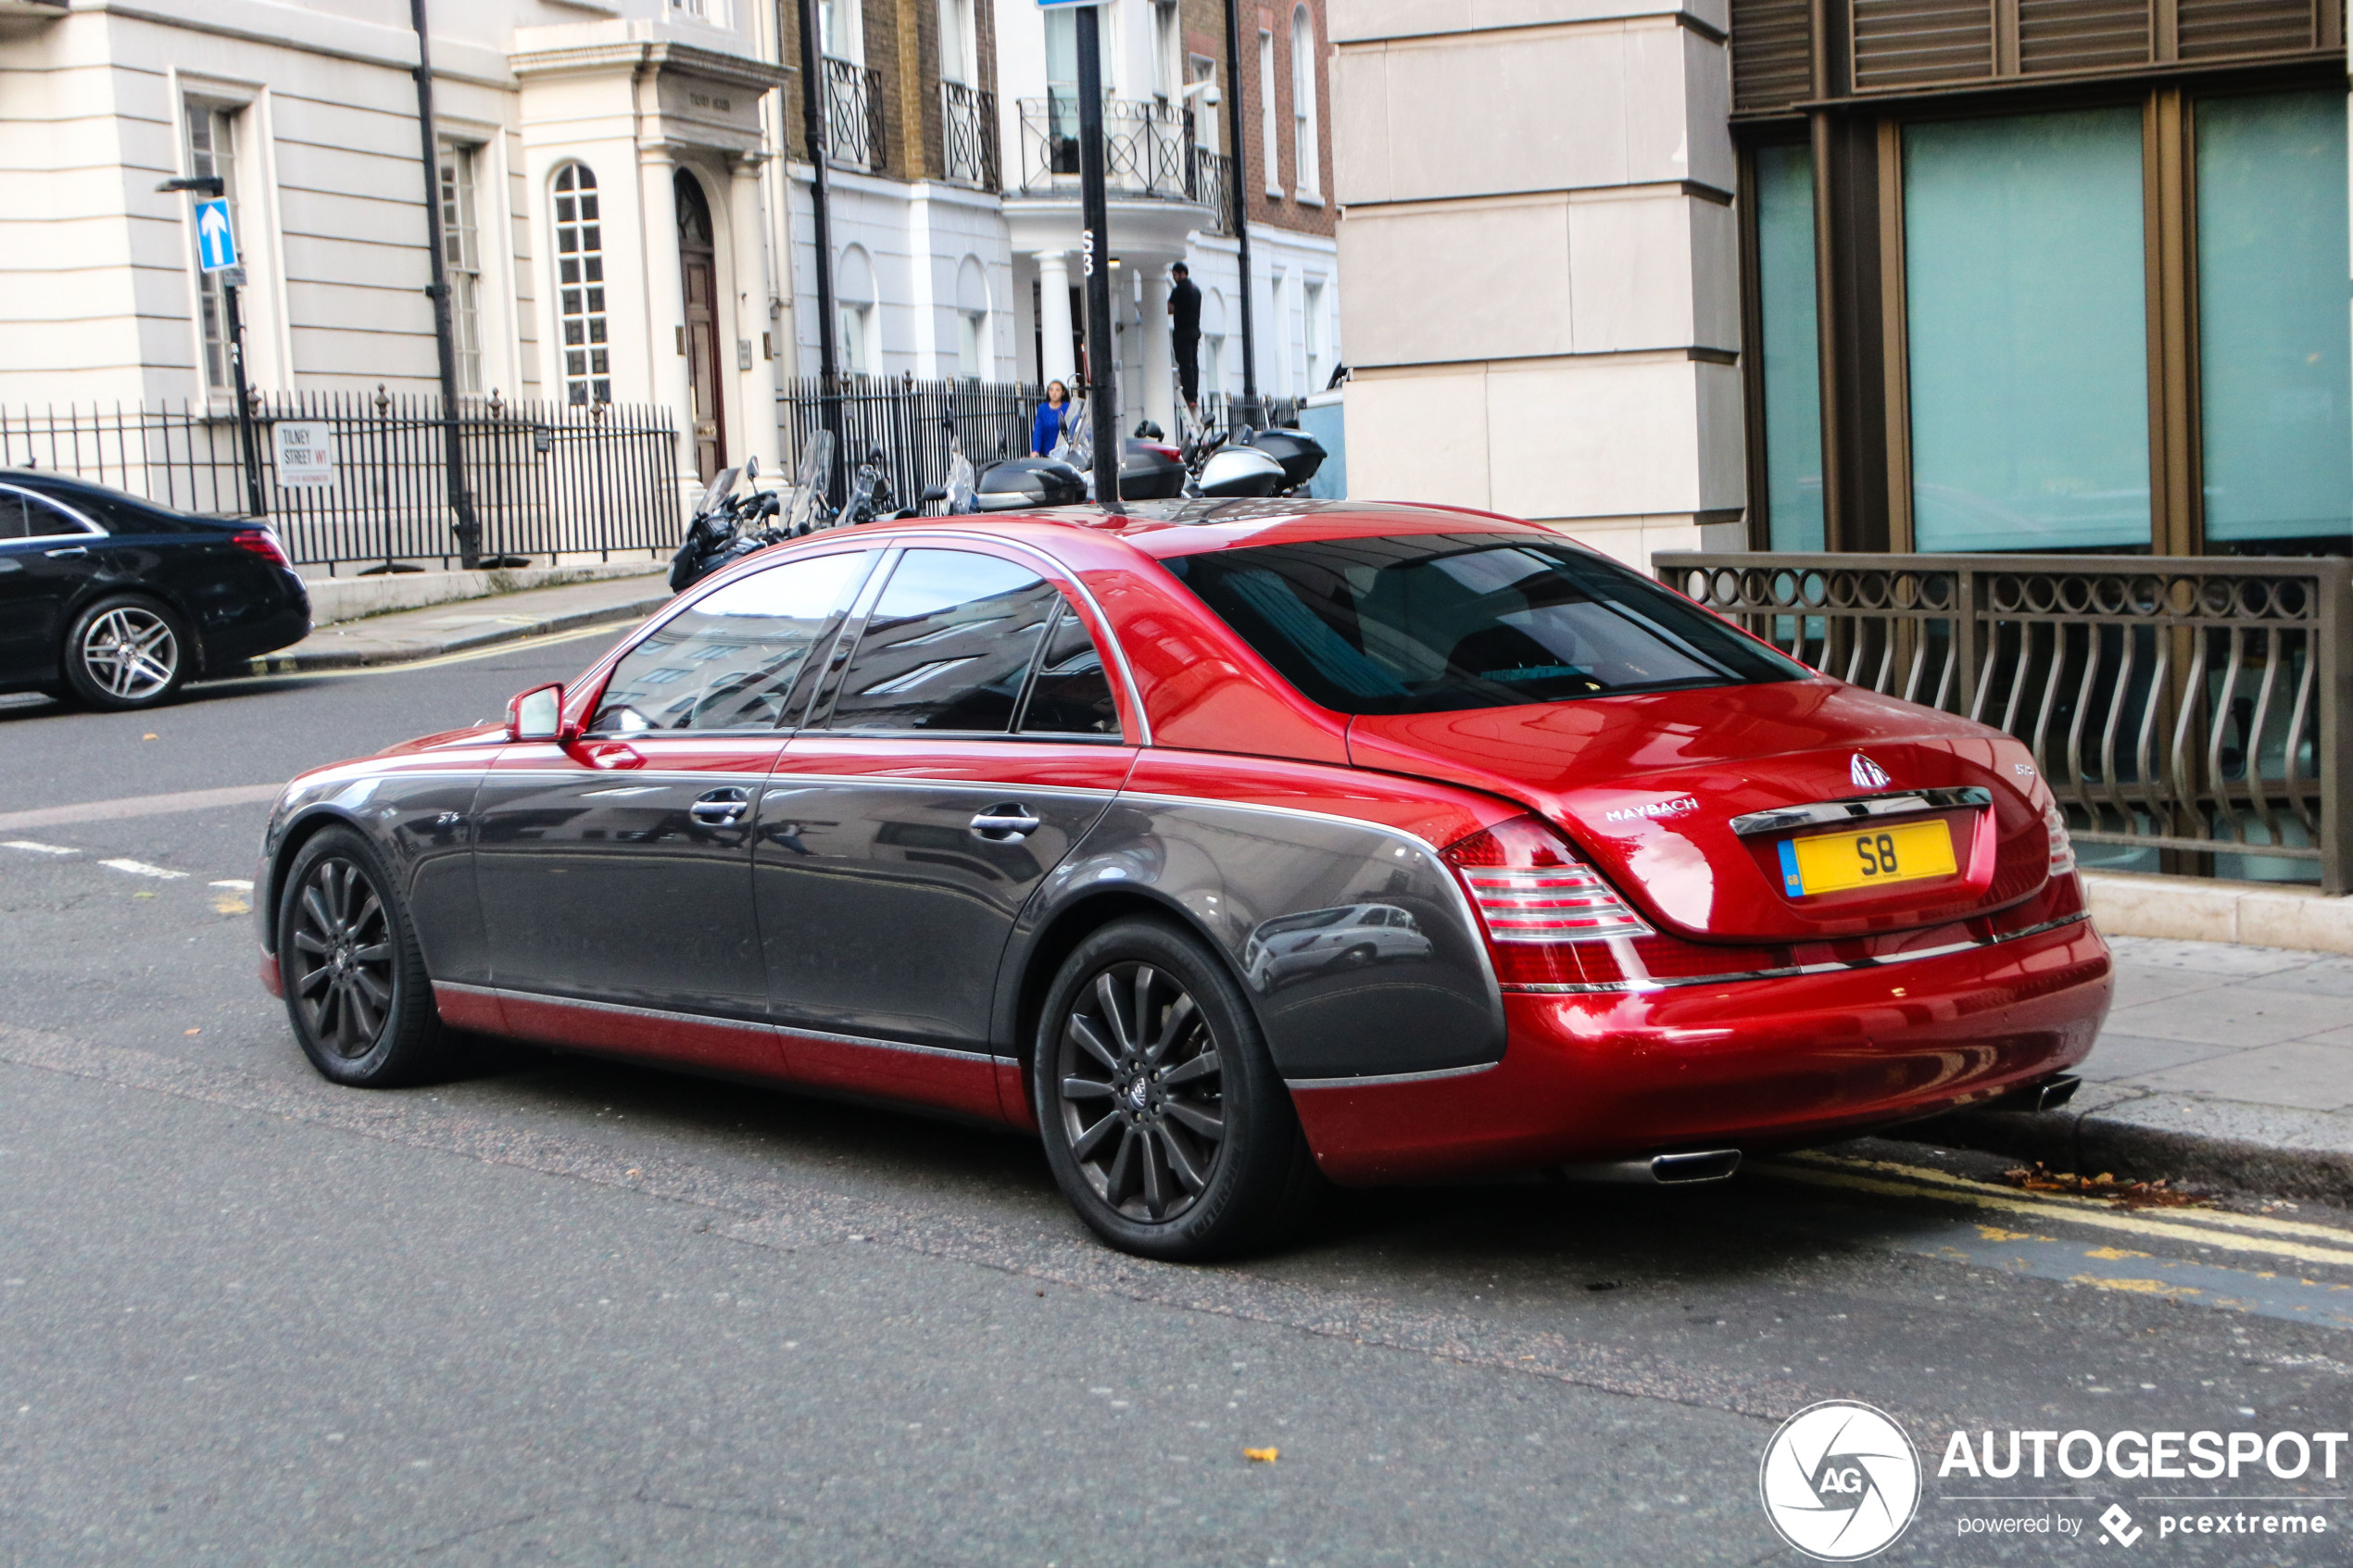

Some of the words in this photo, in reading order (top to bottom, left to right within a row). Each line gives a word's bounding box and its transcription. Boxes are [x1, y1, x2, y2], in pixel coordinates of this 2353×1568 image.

[282, 429, 310, 445] TILNEY
[283, 449, 311, 464] STREET
[315, 449, 327, 464] W1
[1605, 797, 1699, 822] MAYBACH
[1856, 834, 1897, 876] S8
